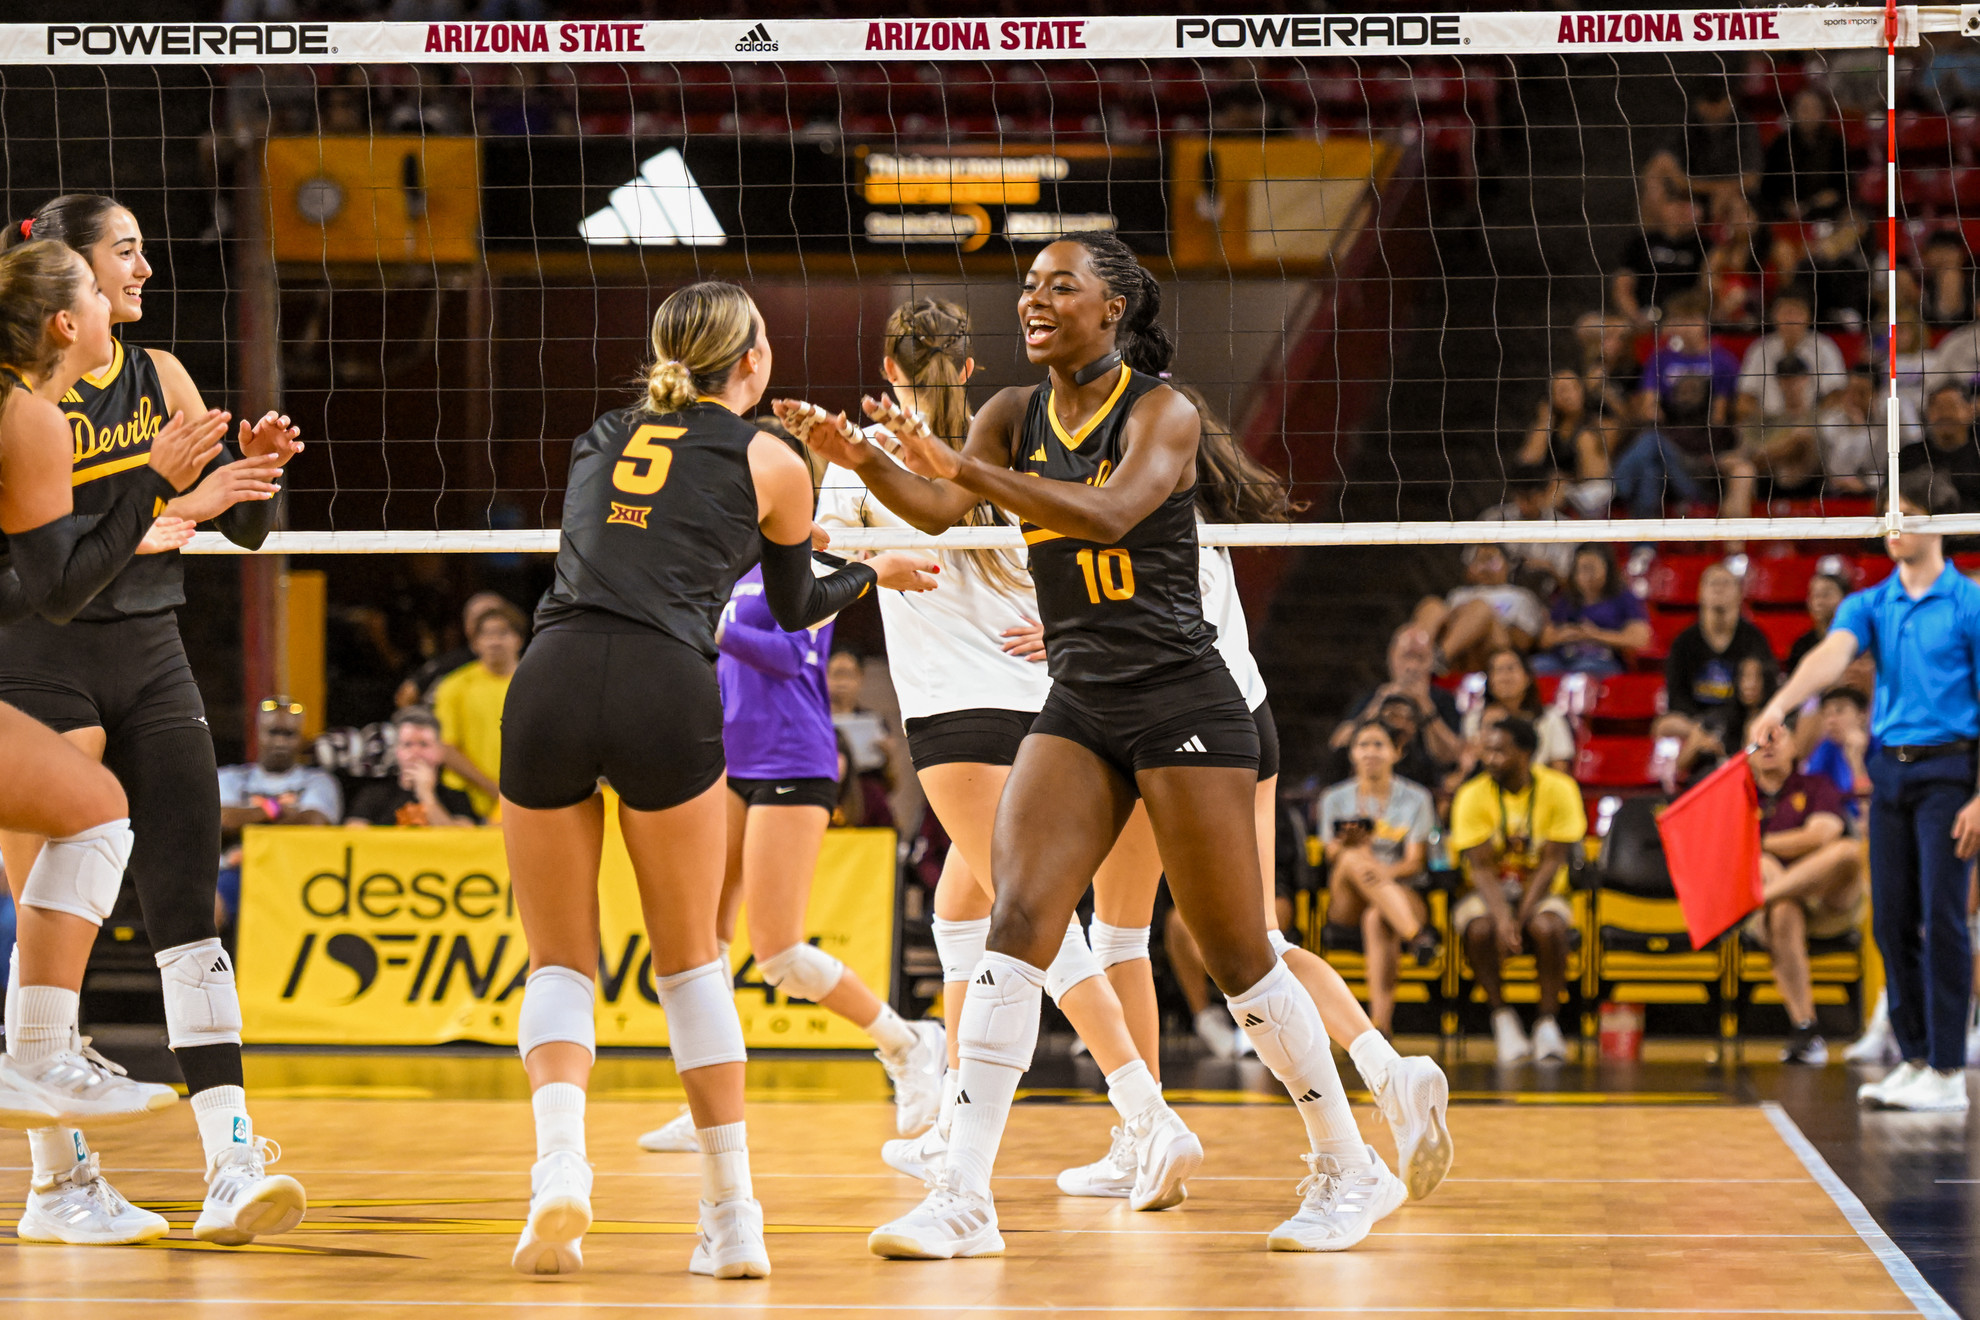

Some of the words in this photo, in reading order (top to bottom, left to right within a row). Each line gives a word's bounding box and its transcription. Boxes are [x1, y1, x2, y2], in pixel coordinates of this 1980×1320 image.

[865, 21, 991, 51] ARIZONA
[999, 20, 1087, 50] STATE
[1557, 13, 1684, 43] ARIZONA
[1693, 11, 1780, 41] STATE
[1824, 18, 1847, 26] sports
[424, 24, 550, 53] ARIZONA
[559, 23, 646, 52] STATE
[735, 40, 779, 52] adidas
[612, 424, 688, 495] 5
[1076, 548, 1136, 604] 10
